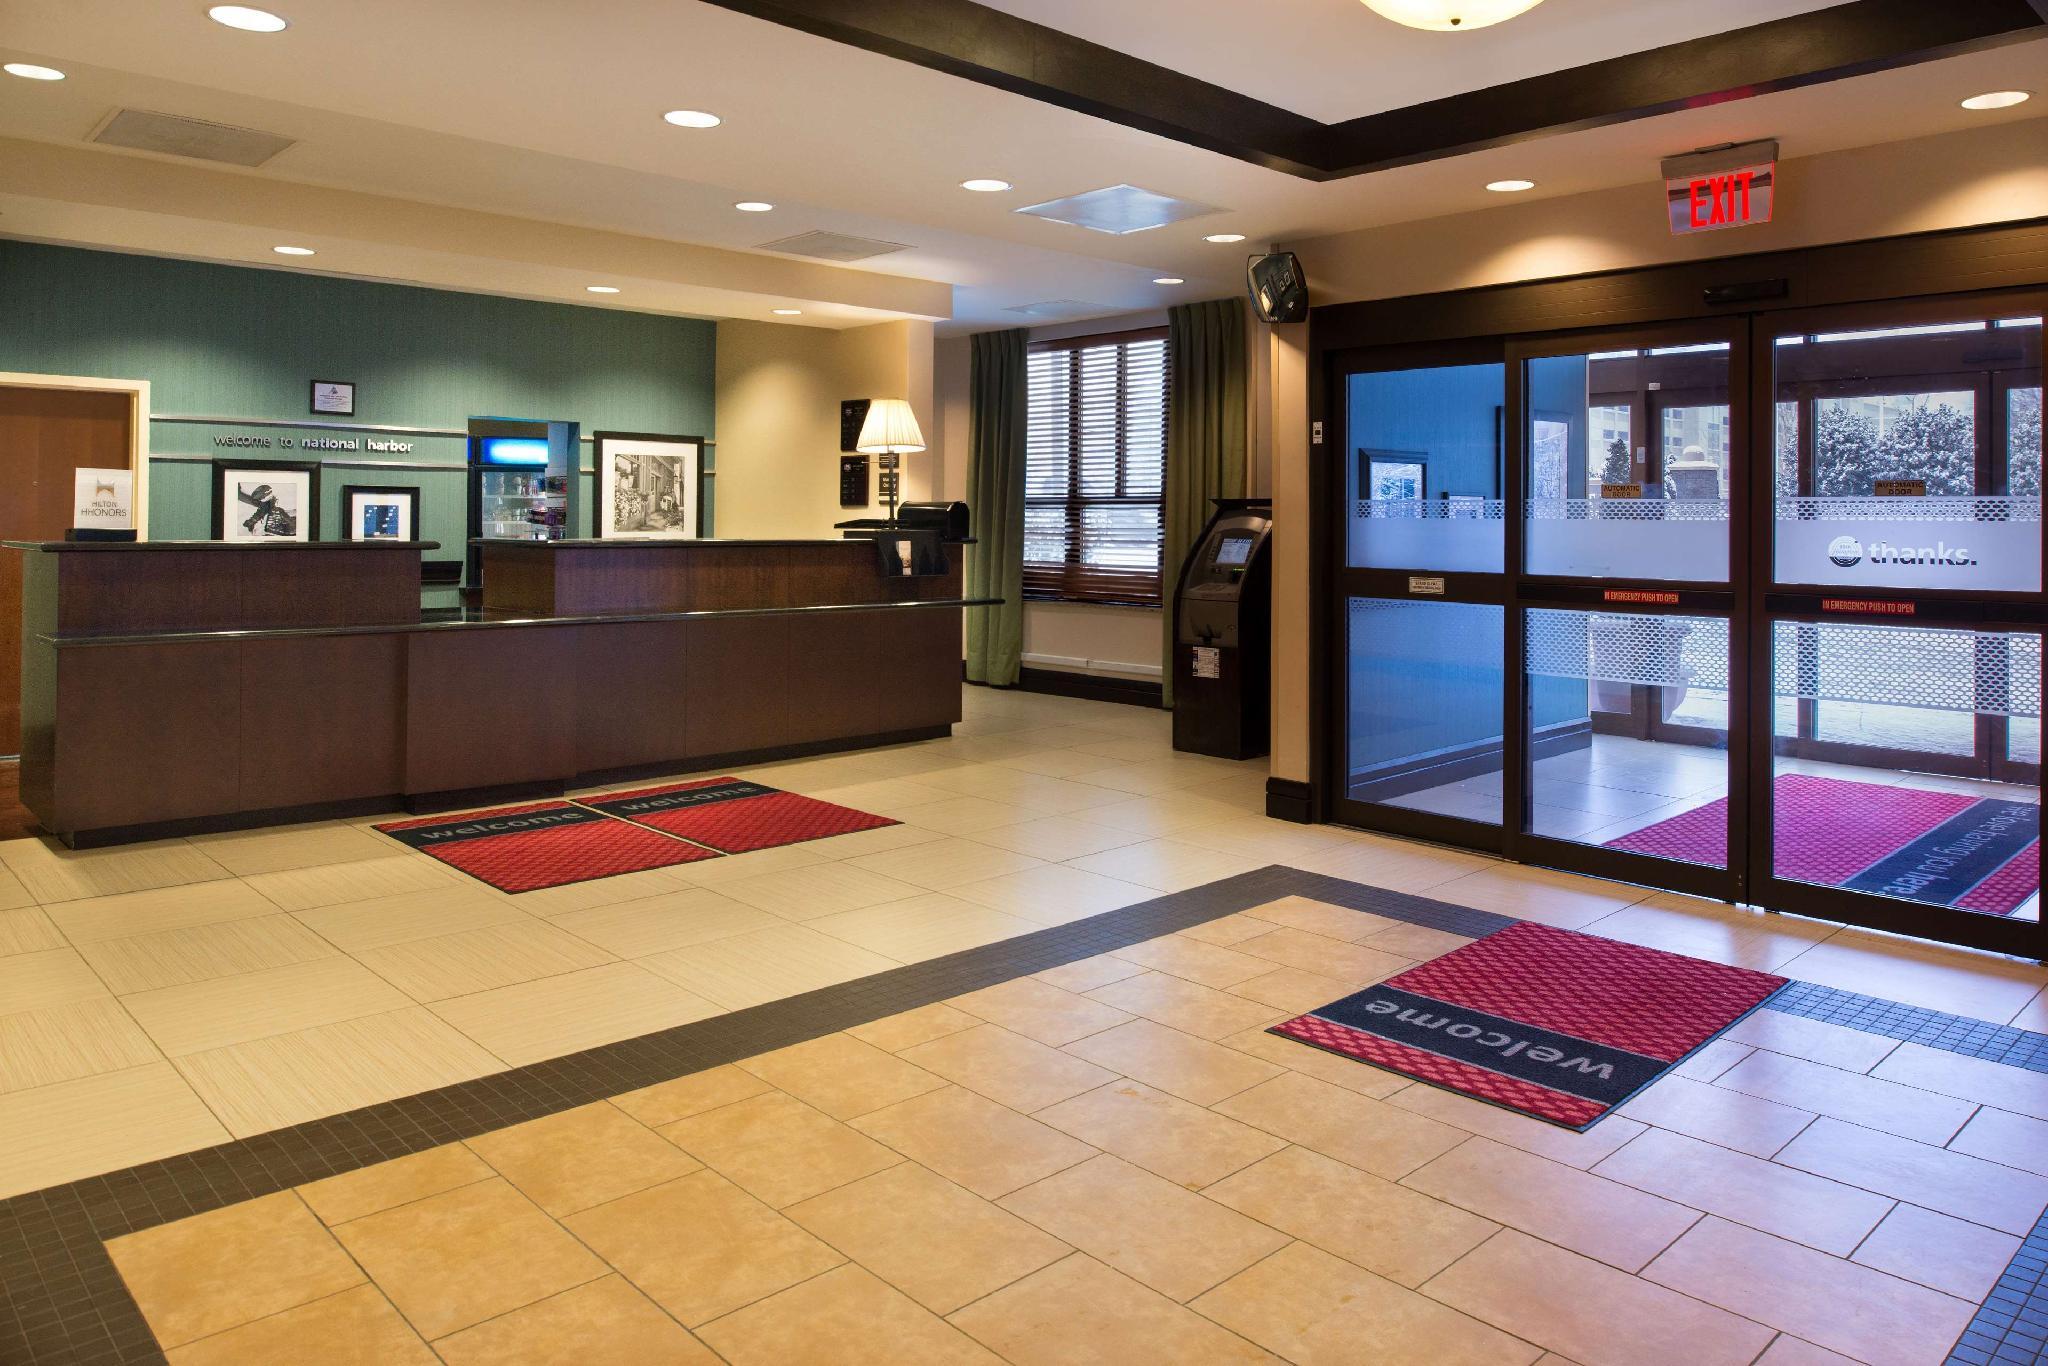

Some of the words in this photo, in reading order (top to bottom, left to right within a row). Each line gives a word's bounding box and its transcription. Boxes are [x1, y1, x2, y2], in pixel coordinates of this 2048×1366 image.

[1690, 171, 1754, 228] EXIT
[214, 433, 271, 447] welcome
[280, 436, 293, 447] to
[301, 437, 360, 450] national
[367, 438, 413, 452] harbor
[81, 508, 127, 517] HHONORS
[91, 500, 117, 508] HILTON
[1868, 541, 1977, 565] thanks.
[1610, 591, 1640, 601] EMERGENCY
[1641, 592, 1656, 602] PUSH
[1656, 593, 1664, 602] TO
[1664, 593, 1679, 603] OPEN
[1822, 599, 1830, 609] IN
[1830, 600, 1868, 611] EMERGENCY
[1868, 601, 1886, 611] PUSH
[1887, 603, 1896, 612] TO
[1897, 603, 1914, 613] OPEN
[621, 784, 759, 811] welcome
[420, 811, 585, 839] welcome
[1364, 1000, 1615, 1080] welcome
